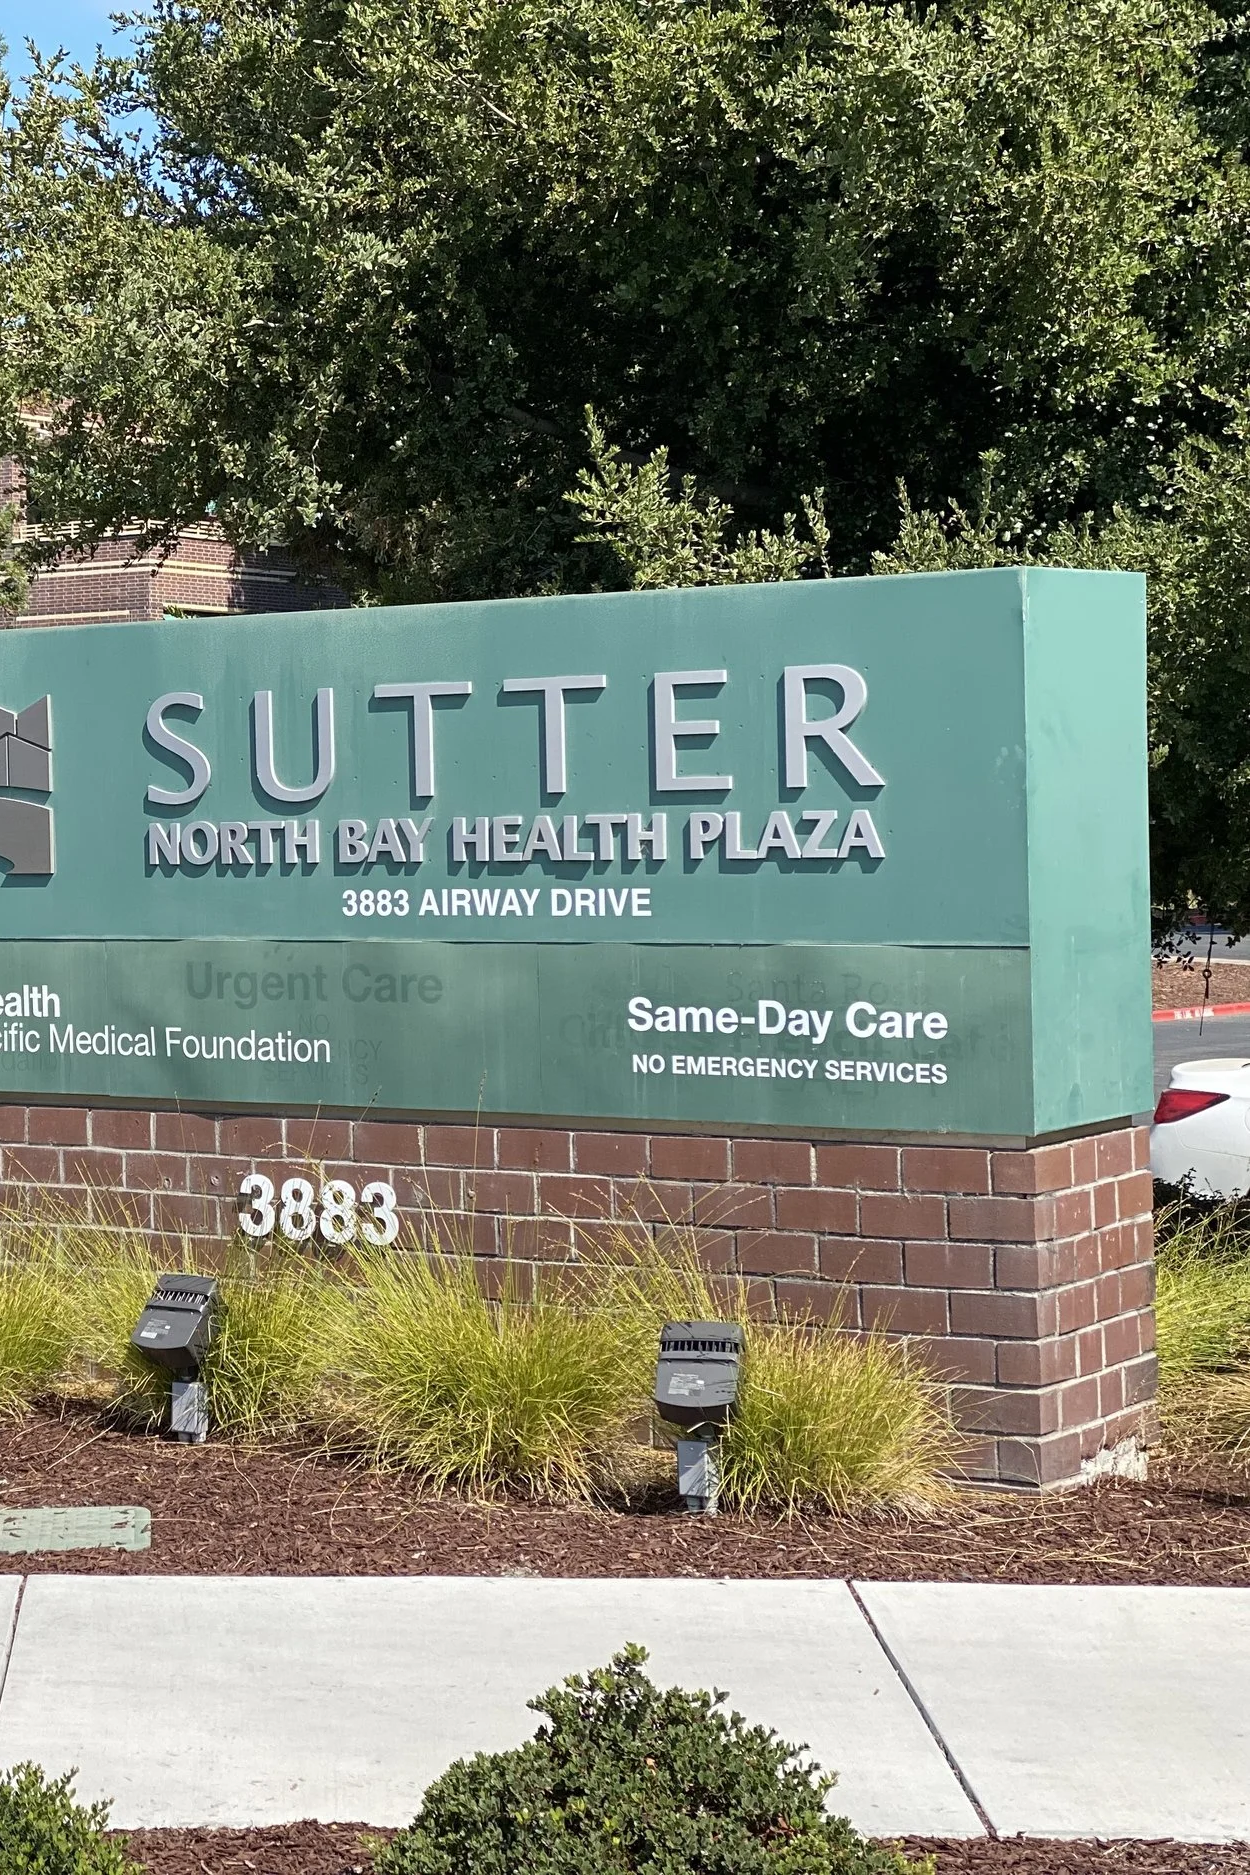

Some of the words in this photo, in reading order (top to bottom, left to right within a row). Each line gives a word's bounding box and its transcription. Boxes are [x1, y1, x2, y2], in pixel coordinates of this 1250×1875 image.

[146, 663, 886, 804] SUTTER
[149, 819, 320, 865] NORTH
[338, 817, 435, 864] BAY
[452, 813, 668, 862] HEALTH
[689, 809, 886, 860] PLAZA
[342, 889, 410, 917] 3883
[418, 888, 541, 917] AIRWAY
[550, 887, 653, 917] DRIVE
[185, 960, 328, 1010] Urgent
[342, 962, 444, 1004] Care
[49, 1023, 156, 1057] Medical
[165, 1026, 331, 1063] Foundation
[627, 996, 834, 1045] Same-Day
[845, 1001, 949, 1040] Care
[632, 1054, 666, 1075] NO
[671, 1055, 819, 1080] EMERGENCY
[824, 1059, 948, 1085] SERVICES
[238, 1173, 400, 1246] 3883
